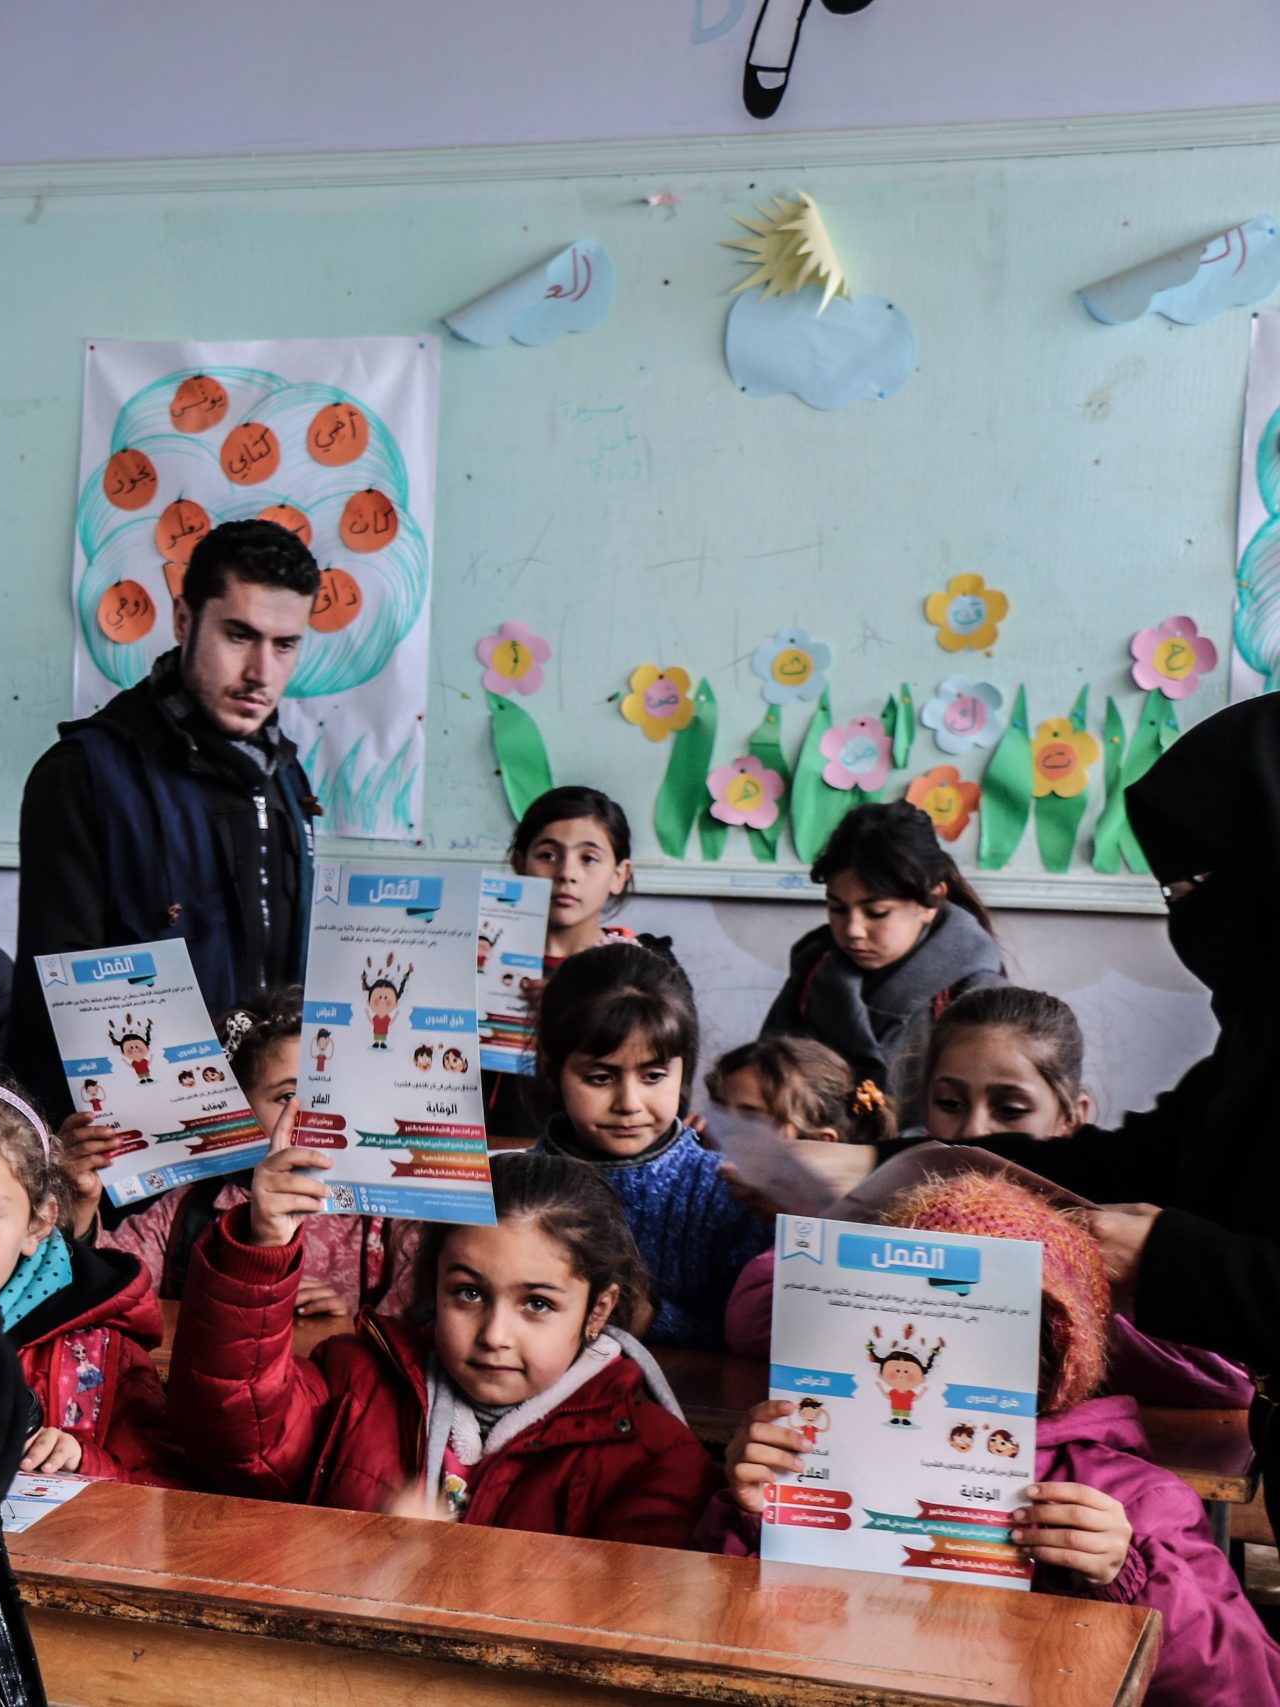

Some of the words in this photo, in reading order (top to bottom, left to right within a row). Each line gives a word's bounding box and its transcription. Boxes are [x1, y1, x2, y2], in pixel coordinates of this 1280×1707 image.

[350, 508, 394, 535] كان
[369, 878, 420, 904] القمل
[92, 956, 136, 981] القمل
[311, 1093, 331, 1109] العلاج
[426, 1101, 458, 1117] الوقاية
[871, 1242, 945, 1270] القمل
[960, 1484, 1000, 1502] الوقاية
